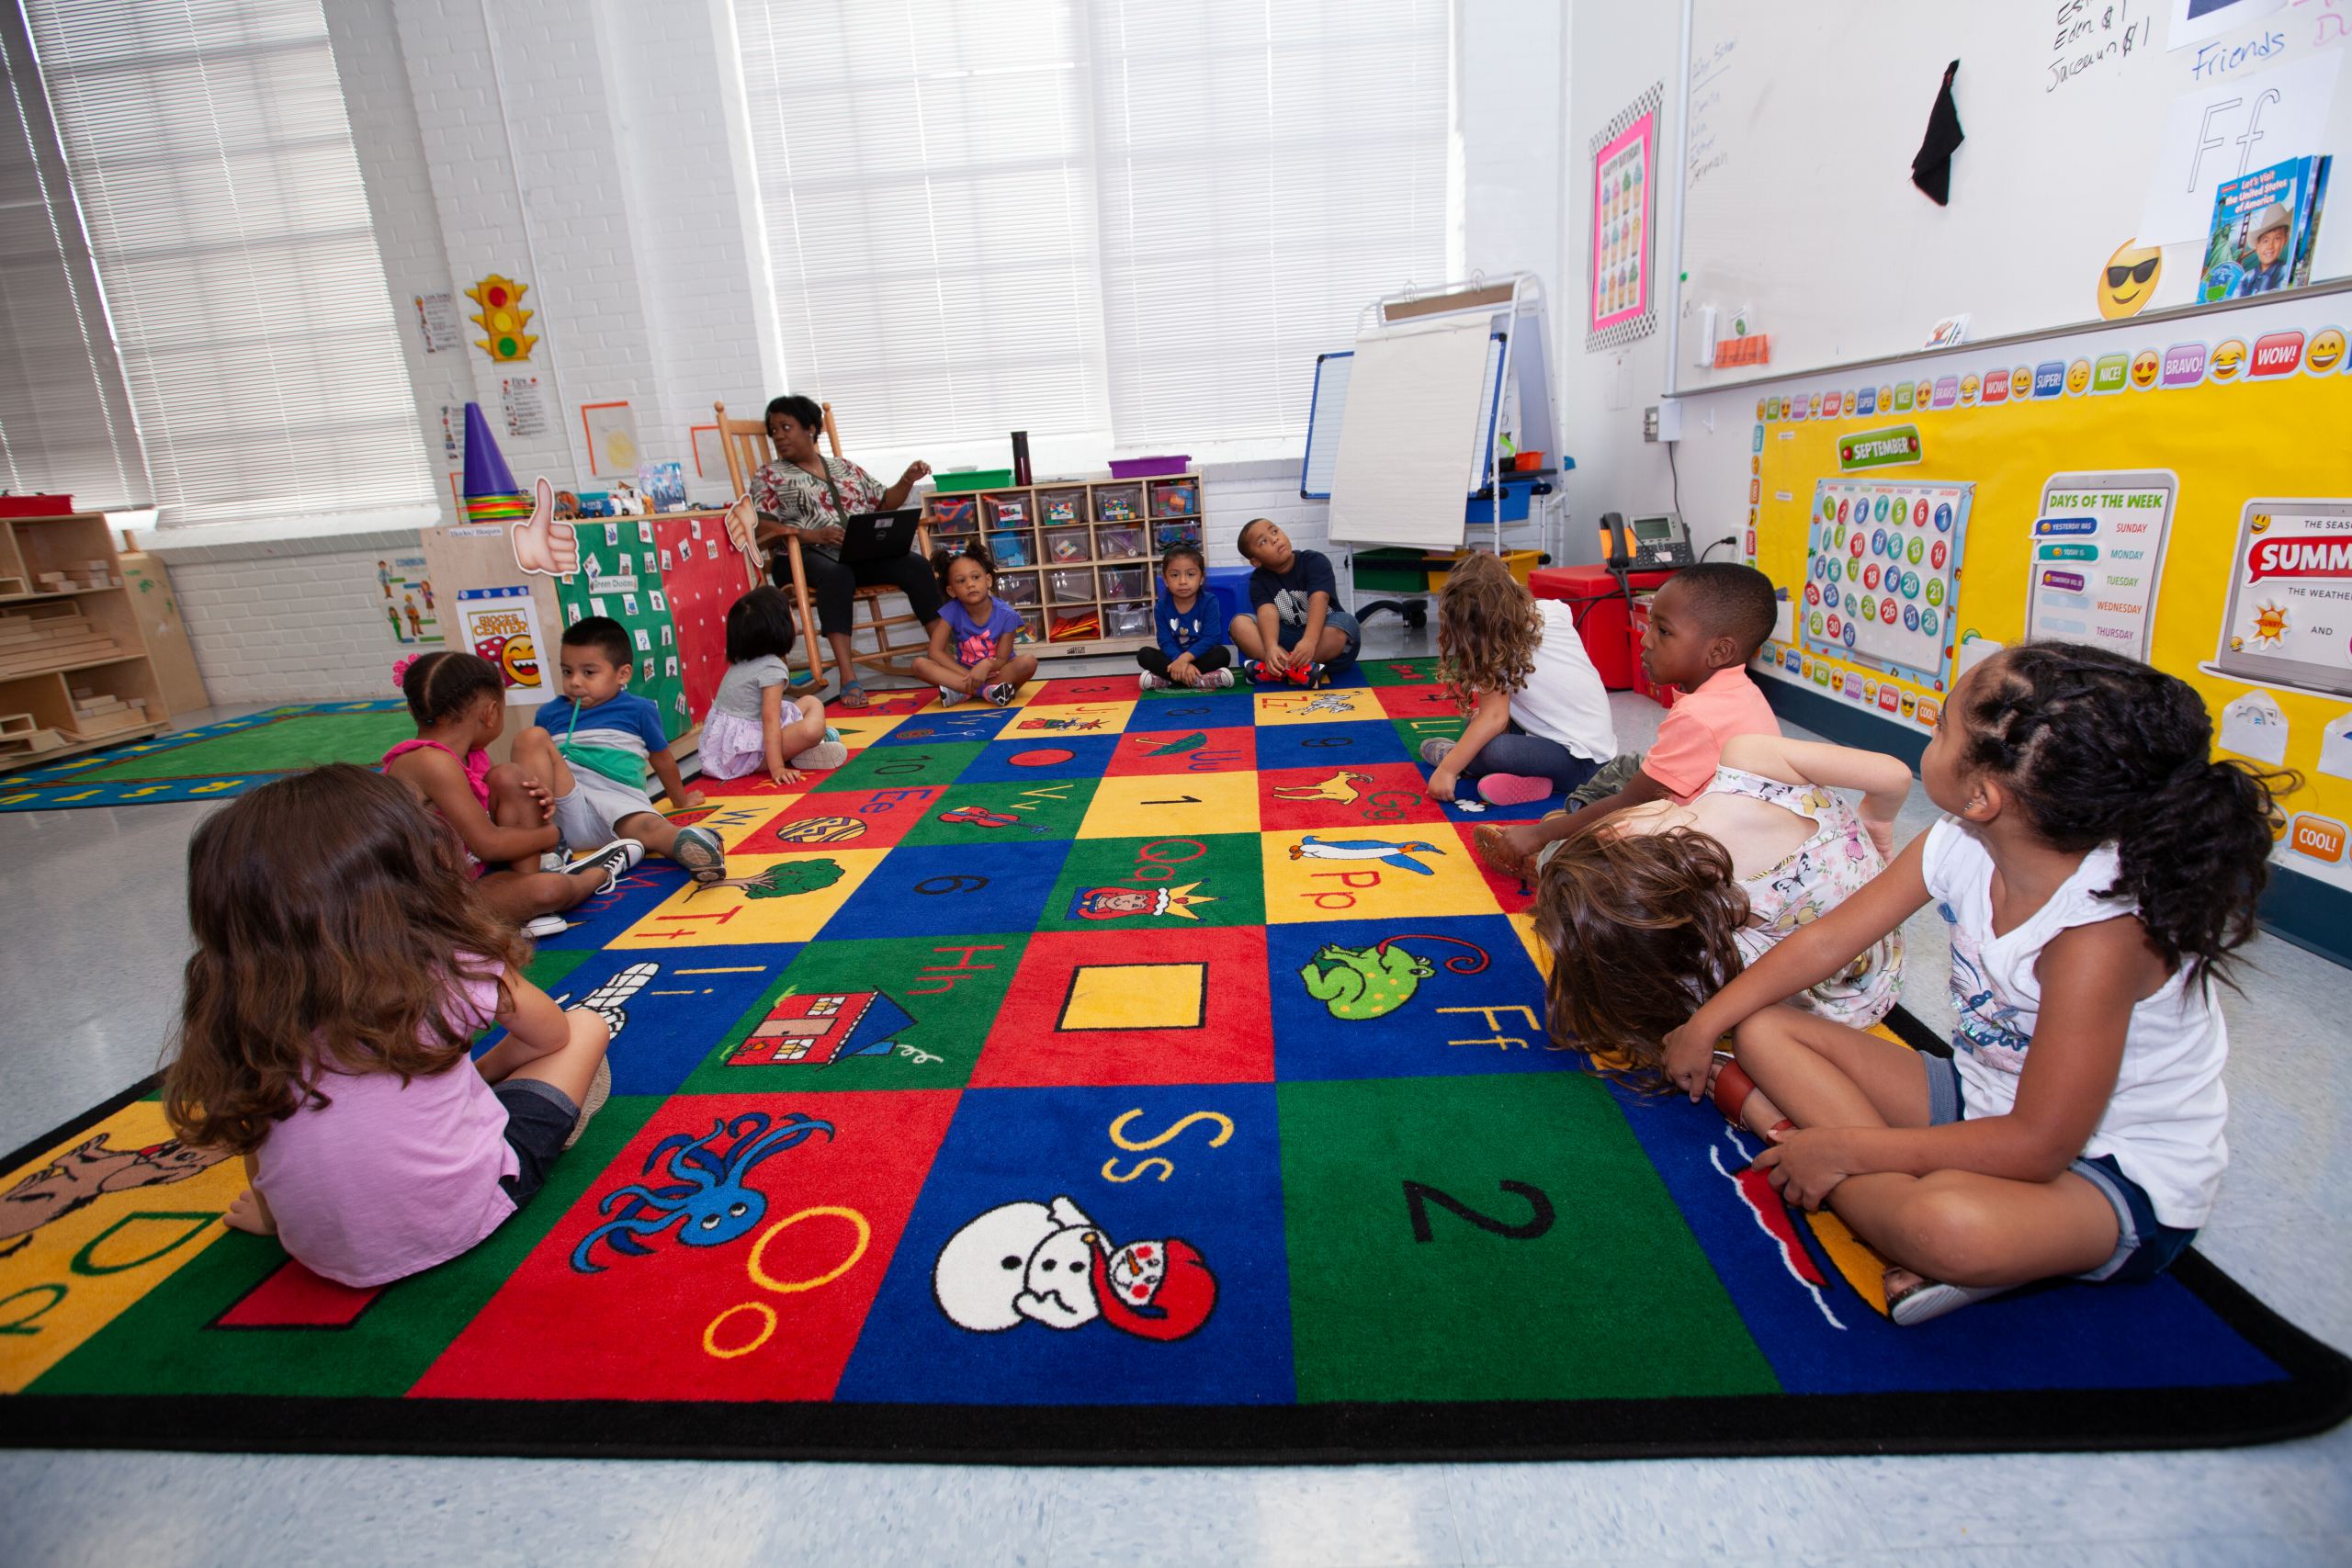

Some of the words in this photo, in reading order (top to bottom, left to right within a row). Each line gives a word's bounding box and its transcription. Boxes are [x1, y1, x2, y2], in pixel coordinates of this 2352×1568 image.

[2192, 32, 2286, 81] Friends
[2241, 177, 2258, 189] Let's
[2260, 170, 2276, 183] Visit
[2225, 196, 2238, 206] the
[2239, 187, 2264, 202] United
[2264, 179, 2288, 194] States
[2234, 204, 2245, 214] of
[2245, 195, 2276, 210] America
[2257, 344, 2298, 366] WOW!
[2098, 366, 2122, 382] NICE!
[2165, 356, 2203, 376] BRAVO!
[1985, 378, 2007, 394] WOW!
[2036, 373, 2061, 389] SUPER!
[1897, 391, 1911, 404] NICE!
[1935, 385, 1956, 400] BRAVO!
[1858, 396, 1874, 409] SUPER!
[1853, 436, 1909, 460] SEPTEMBER
[2049, 494, 2078, 508] DAYS
[2081, 494, 2098, 508] OF
[2101, 494, 2124, 508] THE
[2127, 494, 2164, 508] WEEK
[1859, 505, 1864, 515] 3
[1896, 506, 1902, 515] 5
[1918, 508, 1925, 518] 6
[1941, 512, 1948, 521] 7
[2052, 523, 2080, 531] YESTERDAY
[2116, 523, 2148, 534] SUNDAY
[2304, 520, 2323, 529] THE
[2326, 521, 2352, 529] SEAS
[1853, 540, 1862, 551] 10
[1876, 536, 1883, 547] 11
[1891, 541, 1900, 551] 12
[1911, 545, 1920, 556] 13
[1934, 549, 1943, 561] 14
[2110, 549, 2144, 560] MONDAY
[1868, 570, 1876, 581] 18
[1888, 574, 1896, 584] 19
[1905, 580, 1916, 591] 20
[1930, 587, 1941, 598] 21
[2107, 575, 2139, 588] TUESDAY
[2289, 587, 2306, 596] THE
[2310, 589, 2352, 601] WEATHE
[1826, 590, 1837, 600] 23
[1883, 606, 1895, 618] 26
[1906, 612, 1916, 623] 27
[1925, 615, 1935, 626] 28
[2097, 601, 2142, 615] WEDNESDAY
[479, 614, 519, 626] BLOCKS
[1829, 621, 1838, 633] 30
[2259, 618, 2281, 628] SUNNY
[473, 621, 528, 636] CENTER
[2097, 626, 2133, 640] THURSDAY
[2311, 626, 2334, 637] AND
[1787, 658, 1801, 670] SUPER!
[1815, 669, 1827, 680] NICE!
[1071, 685, 1110, 694] 3
[1882, 694, 1896, 707] WOW!
[1165, 706, 1212, 716] 8
[1919, 706, 1935, 721] COOL!
[875, 754, 934, 775] 10
[858, 789, 933, 814] Ee
[1140, 795, 1203, 806] 1
[1362, 790, 1422, 821] Gg
[2299, 828, 2336, 852] COOL!
[1120, 839, 1207, 882] Qq
[1300, 870, 1381, 909] Pp
[634, 906, 743, 940] Tt
[906, 944, 1005, 996] Hh
[1435, 1005, 1542, 1051] Ff
[1102, 1108, 1236, 1183] Ss
[1402, 1179, 1555, 1243] 2
